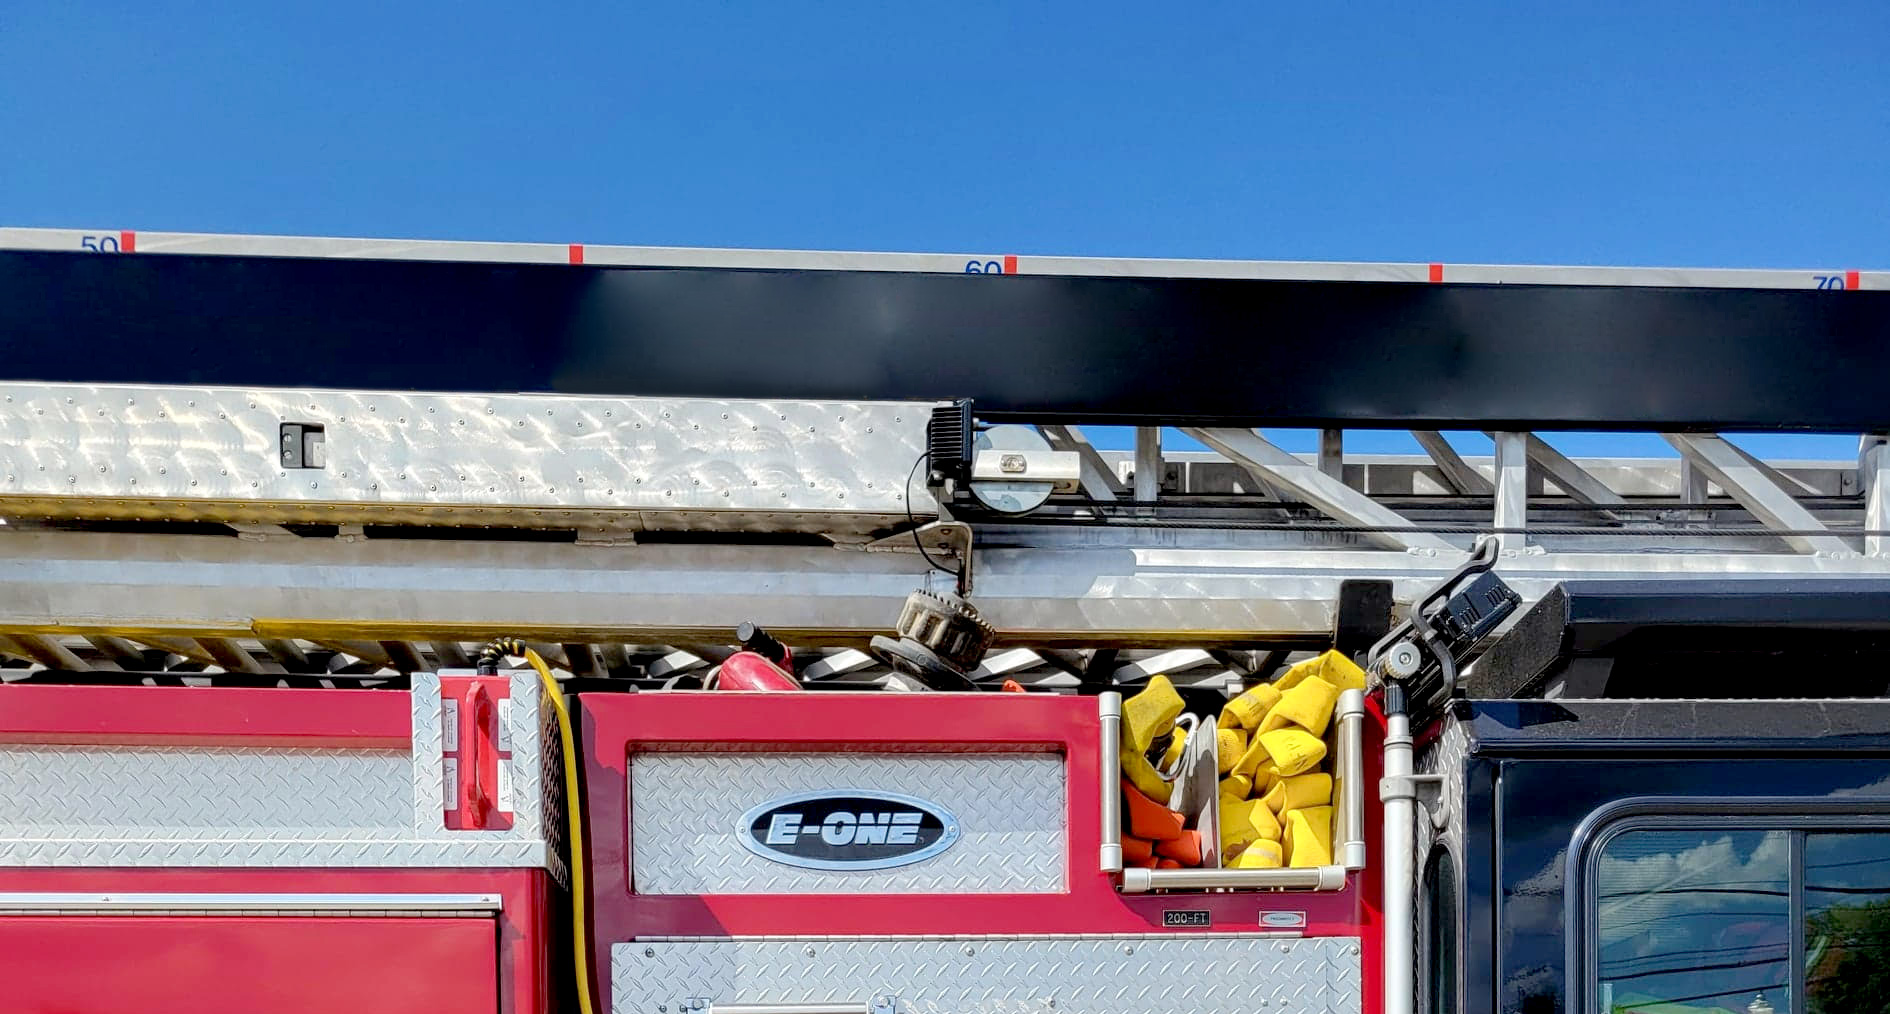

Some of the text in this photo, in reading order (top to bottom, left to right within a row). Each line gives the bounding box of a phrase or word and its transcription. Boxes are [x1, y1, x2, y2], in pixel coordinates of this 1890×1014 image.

[81, 236, 119, 253] 50
[766, 811, 923, 846] E-ONE
[1166, 912, 1206, 924] 200-FT
